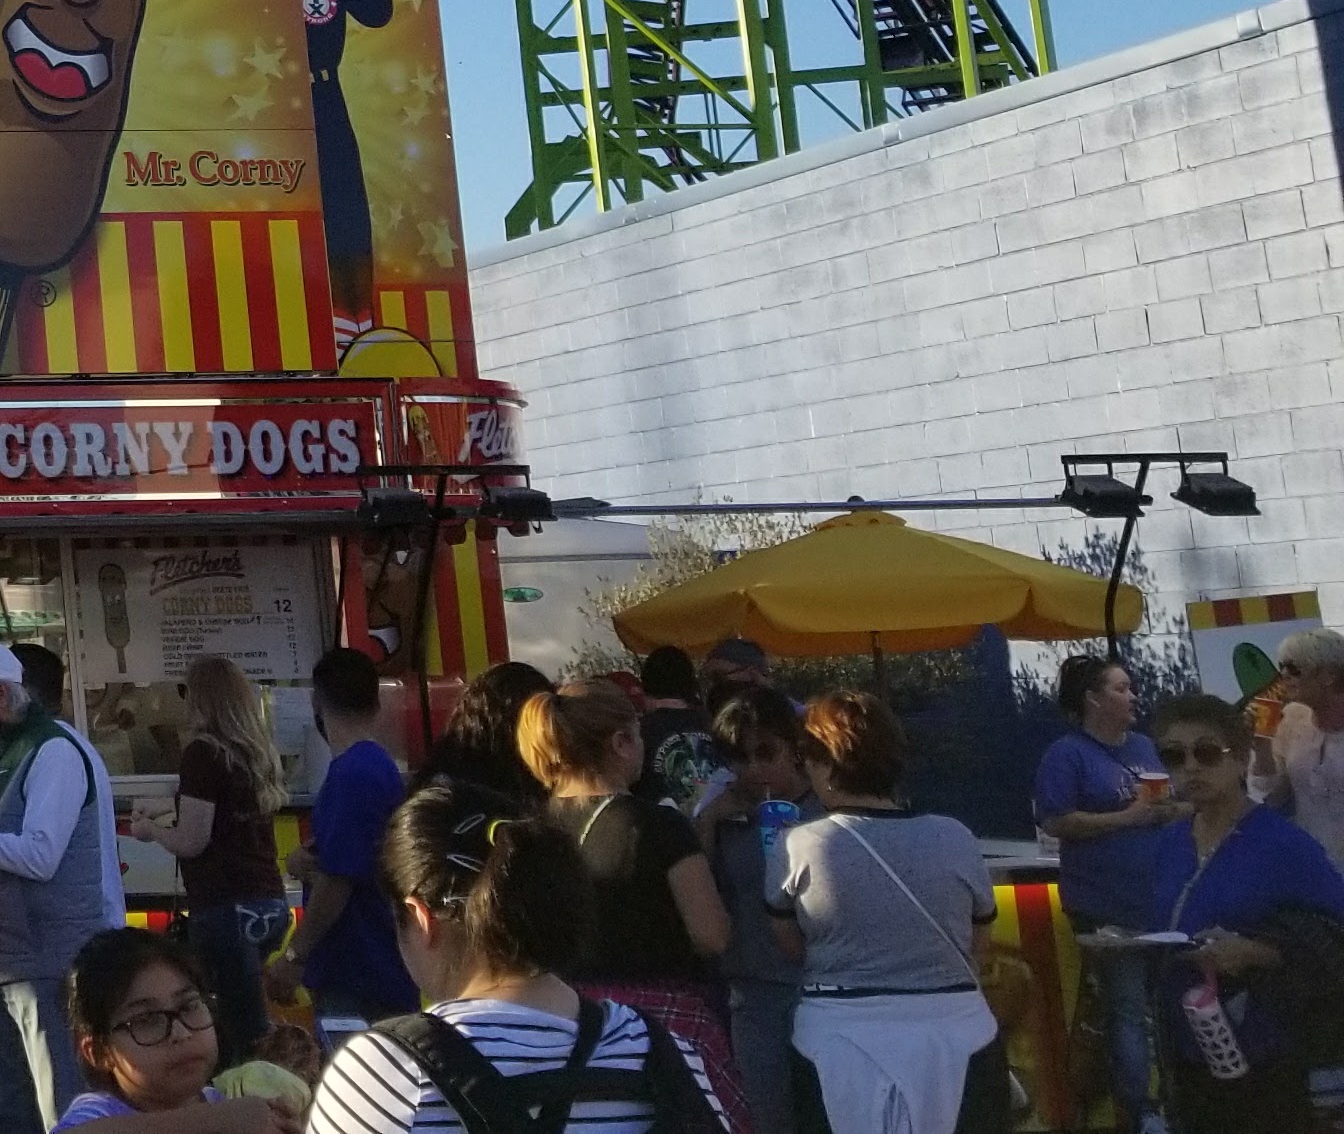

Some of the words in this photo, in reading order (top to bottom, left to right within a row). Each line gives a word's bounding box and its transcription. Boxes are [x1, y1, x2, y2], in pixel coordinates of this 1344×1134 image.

[124, 151, 186, 186] Mr.
[189, 151, 305, 193] Corny
[207, 419, 361, 475] DOGS
[273, 599, 292, 613] 12
